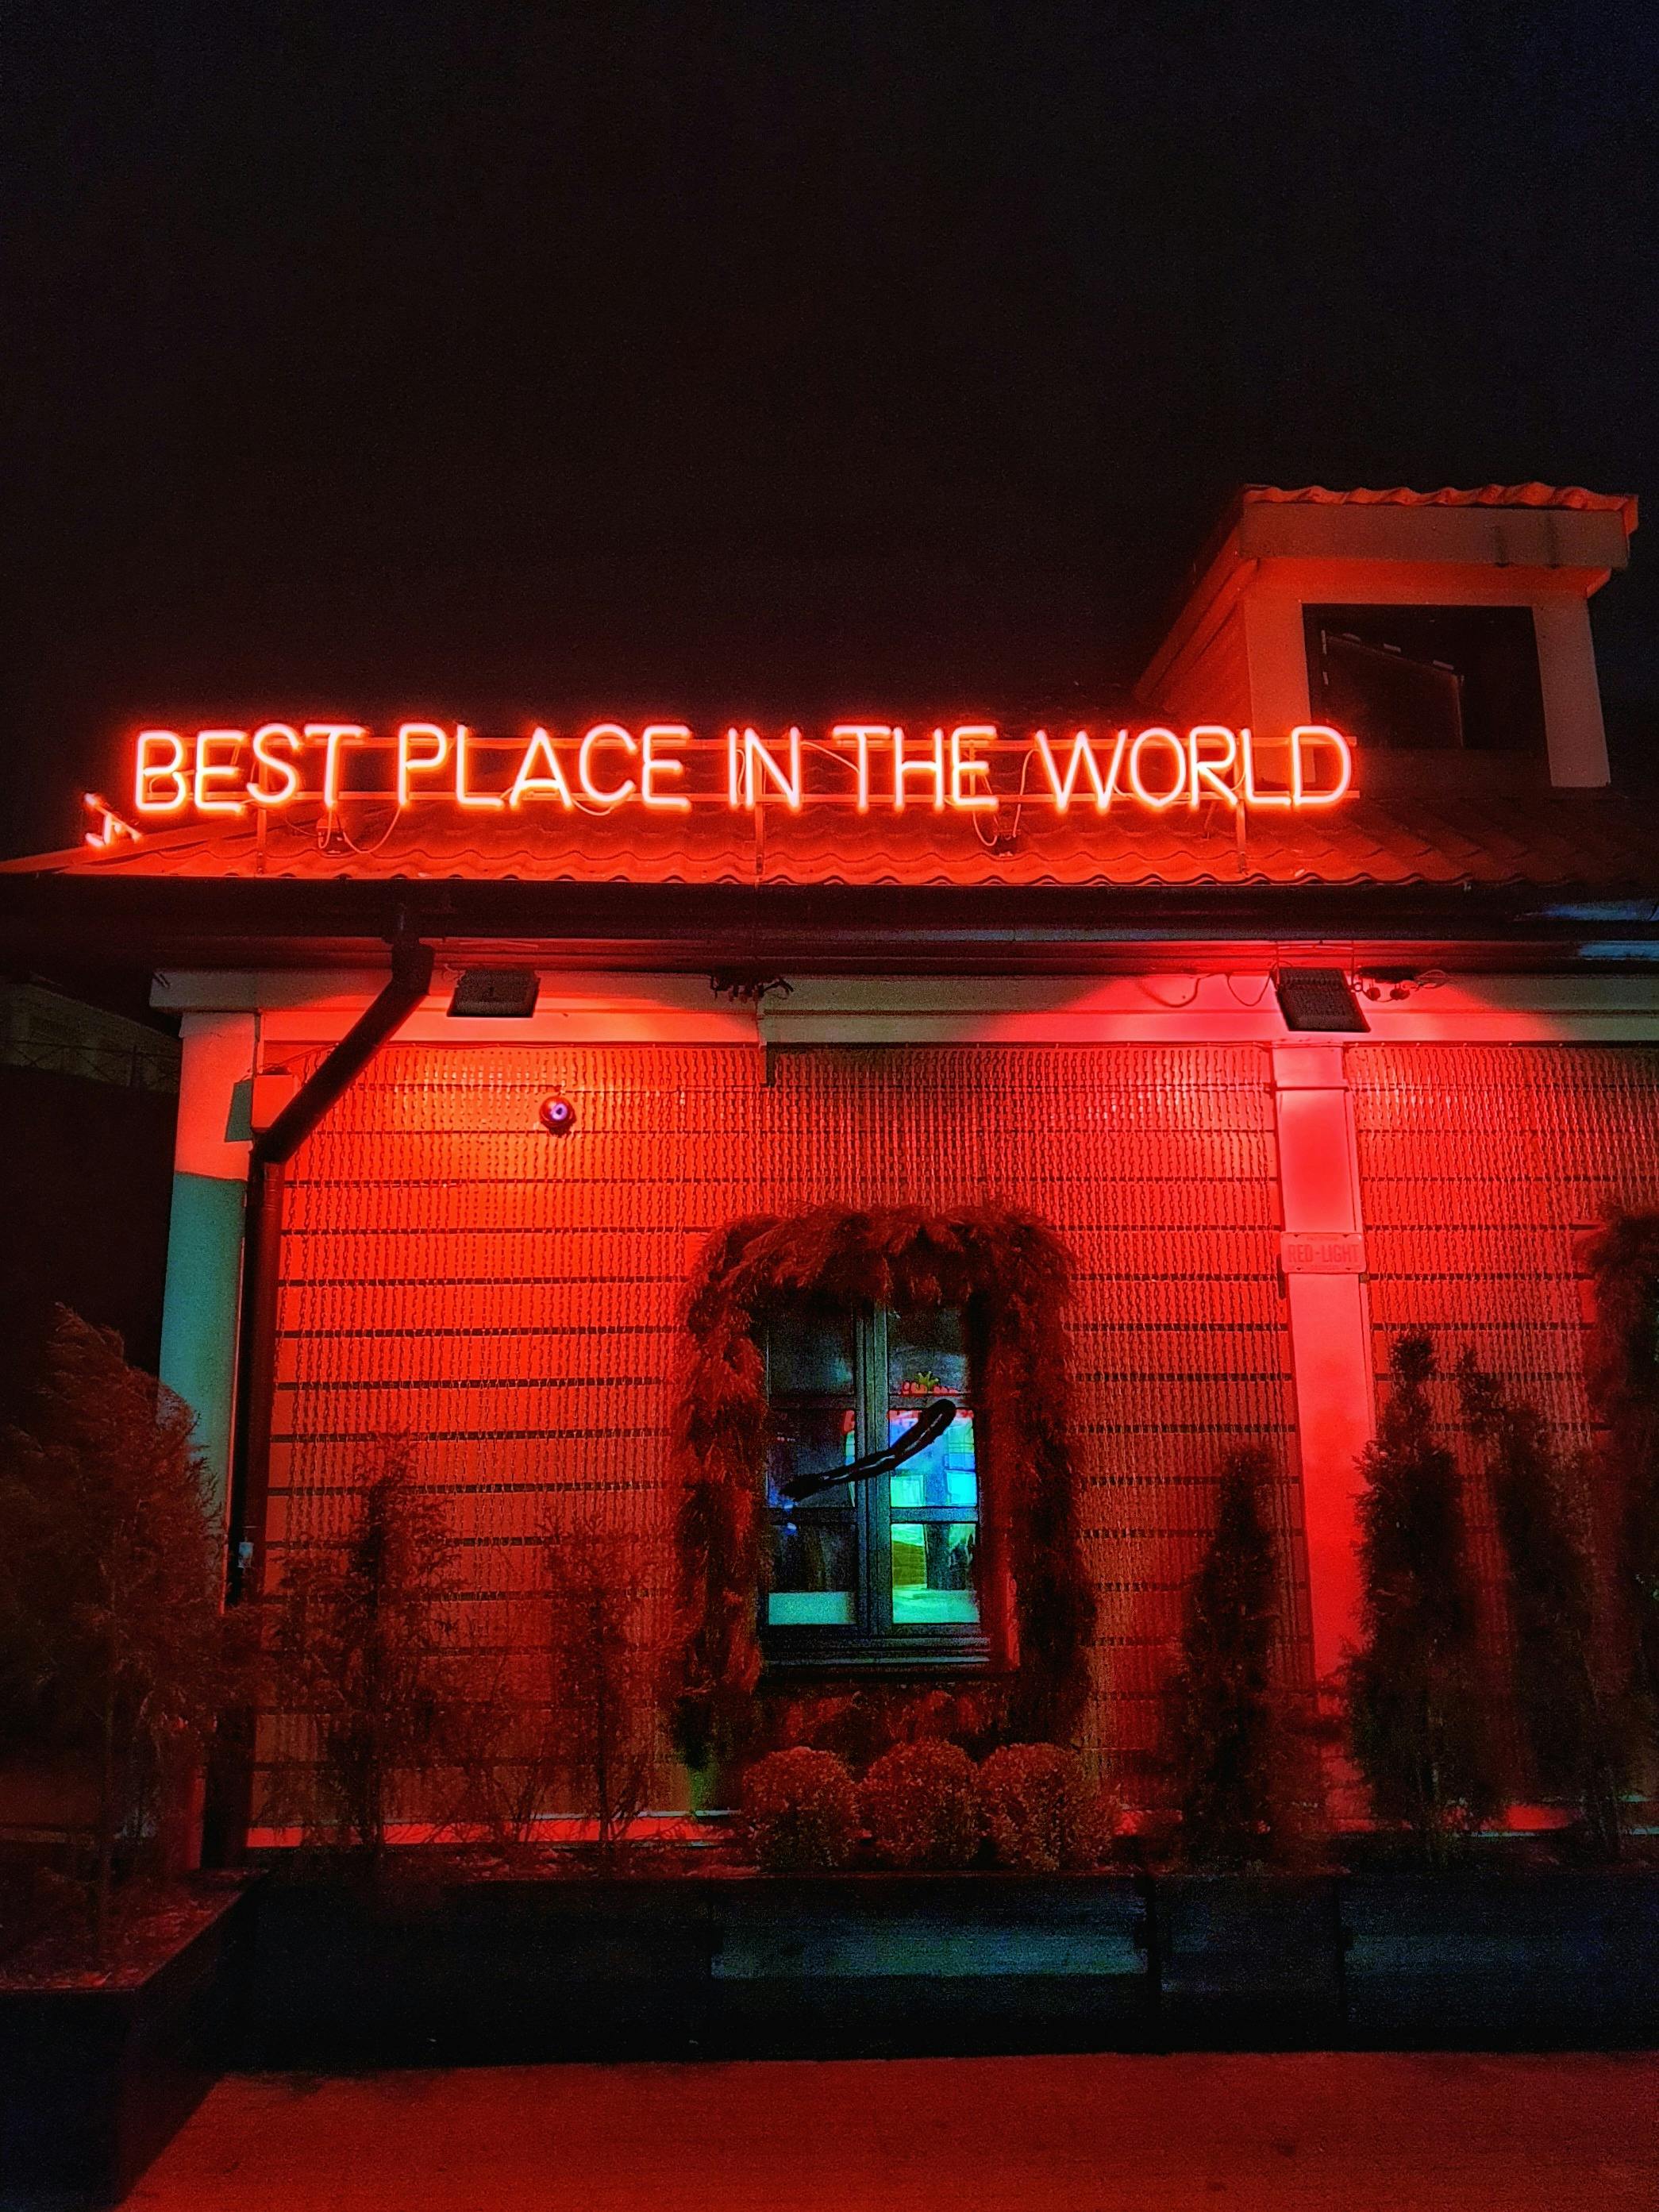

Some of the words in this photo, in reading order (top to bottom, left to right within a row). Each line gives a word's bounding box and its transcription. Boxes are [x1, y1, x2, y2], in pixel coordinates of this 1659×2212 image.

[135, 723, 366, 811] BEST
[397, 723, 690, 811] PLACE
[726, 726, 801, 810] IN
[832, 724, 999, 811] THE
[1034, 724, 1353, 812] WORLD
